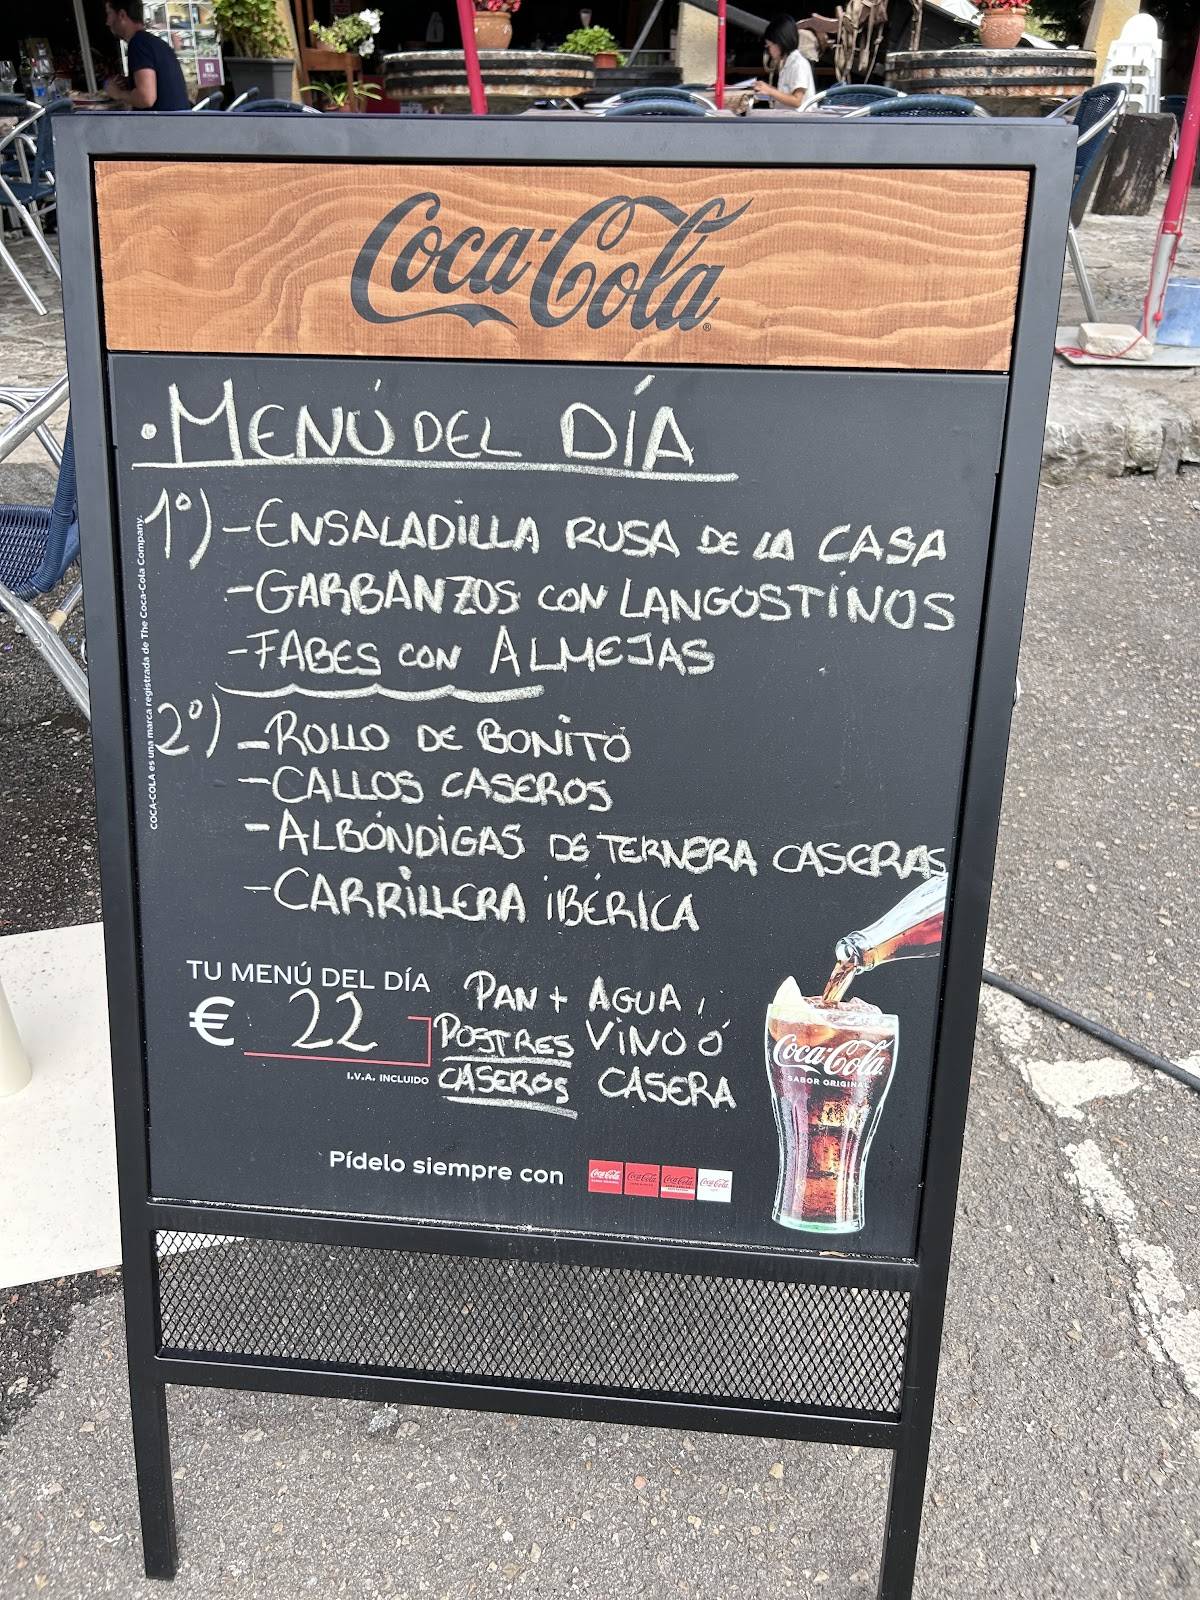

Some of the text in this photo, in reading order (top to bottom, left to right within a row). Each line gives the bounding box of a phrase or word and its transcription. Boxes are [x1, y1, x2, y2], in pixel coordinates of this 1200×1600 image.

[350, 191, 754, 332] Coca-Cola
[168, 374, 695, 471] MENÚ DEL DÍA
[566, 515, 681, 559] RUSA
[696, 524, 740, 557] DE
[752, 528, 795, 562] LA
[818, 523, 948, 568] CASA
[537, 582, 608, 614] CON
[619, 570, 956, 632] LANGOSTINOS
[136, 514, 158, 831] COCA-COLA es una marca registrada de The Coca-Cola Company.
[398, 642, 463, 671] CON
[489, 624, 716, 677] ALMEJAS
[417, 724, 464, 753] DE
[476, 714, 632, 763] BONITO
[441, 767, 613, 812] CASEROS
[549, 832, 590, 862] DE
[597, 832, 758, 877] TERNERA
[772, 840, 948, 880] CASERAS
[546, 873, 700, 931] IBÉRICA
[186, 959, 431, 993] TU MENÚ DEL DÍA
[463, 970, 538, 1012] PAN
[549, 985, 568, 1014] +
[188, 987, 379, 1052] € 22
[433, 1012, 575, 1058] POSTRES
[586, 1016, 687, 1057] VINO
[773, 1033, 894, 1076] Coca-Cola
[346, 1070, 430, 1086] I.V.A. INCLUIDO
[438, 1063, 570, 1104] CASEROS
[598, 1066, 738, 1110] CASERA
[788, 1074, 870, 1089] SABOR ORIGINAL
[329, 1150, 564, 1185] Pídelo siempre con
